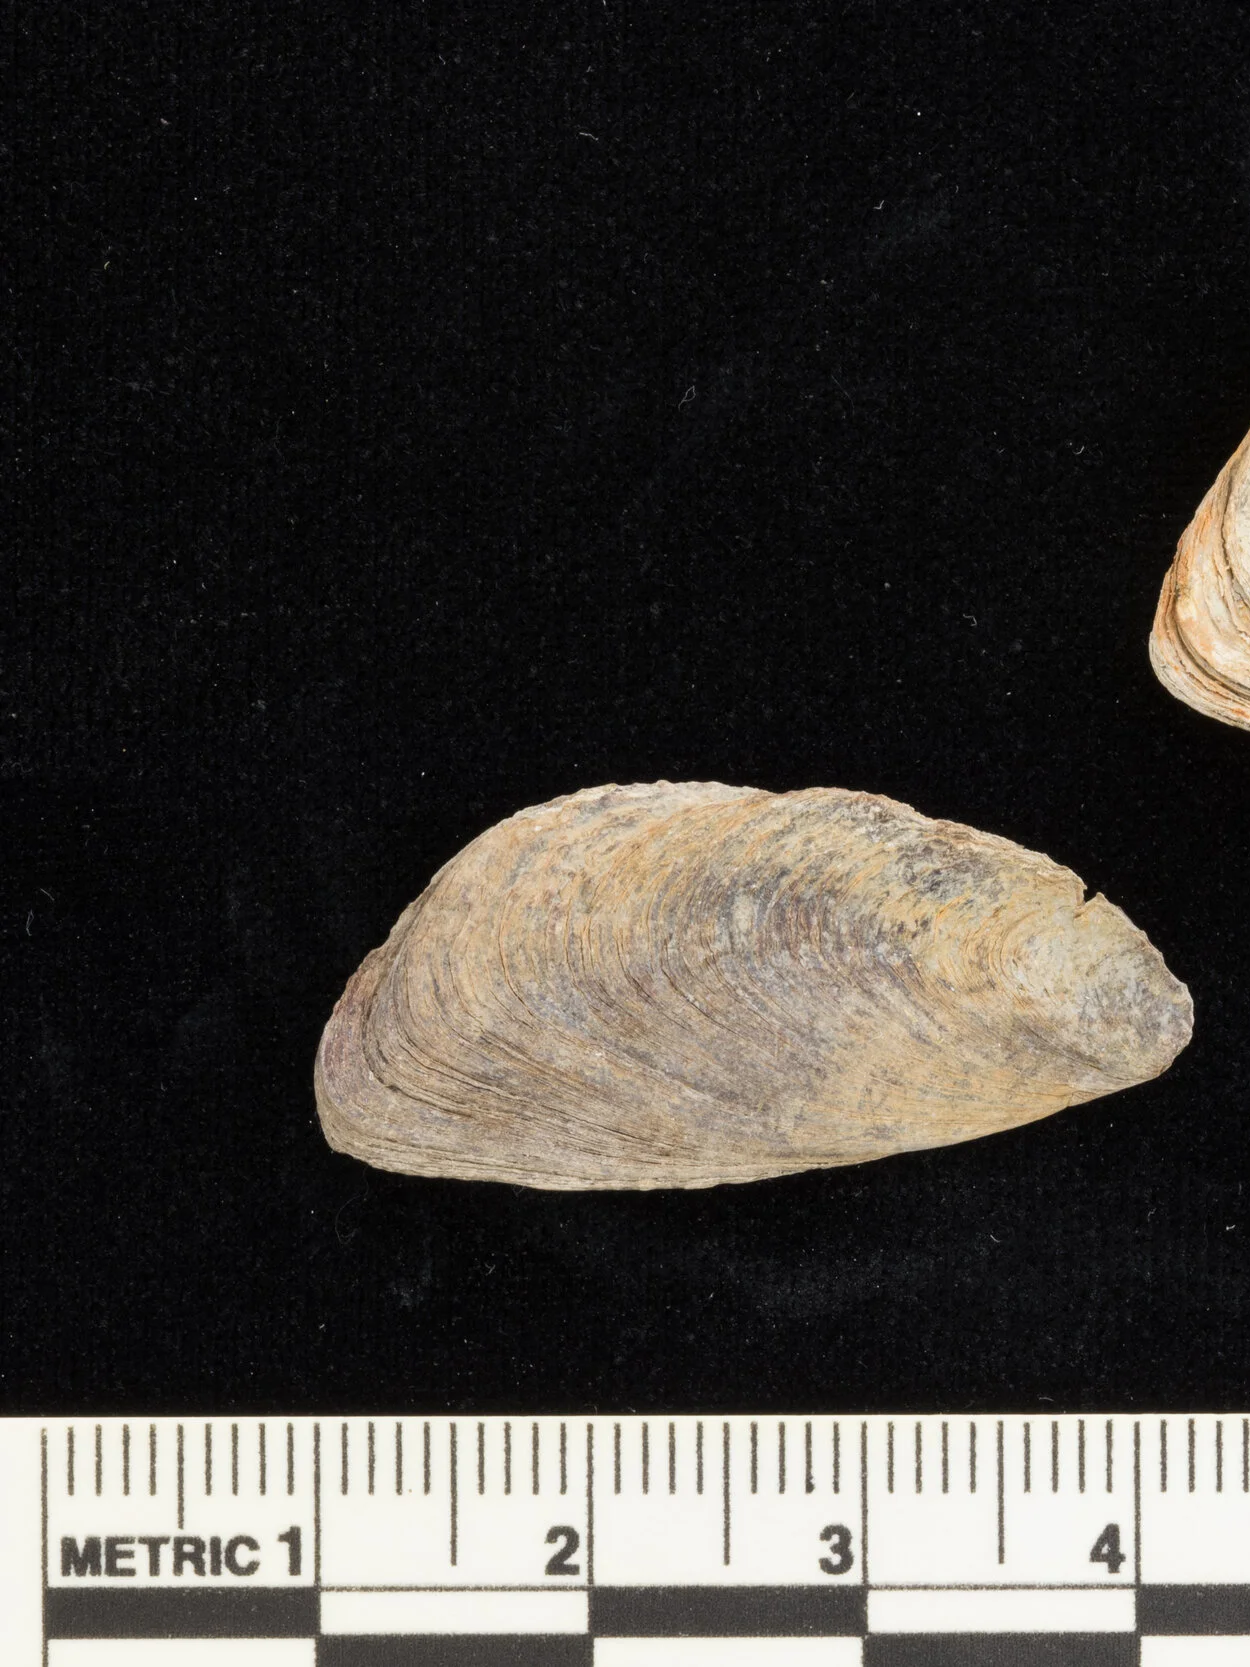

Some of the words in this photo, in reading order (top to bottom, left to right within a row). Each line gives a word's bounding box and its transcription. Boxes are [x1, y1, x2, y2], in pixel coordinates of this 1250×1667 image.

[62, 1536, 259, 1576] METRIC
[279, 1527, 301, 1575] 1
[546, 1527, 579, 1575] 2
[820, 1526, 853, 1574] 3
[1091, 1524, 1125, 1573] 4
